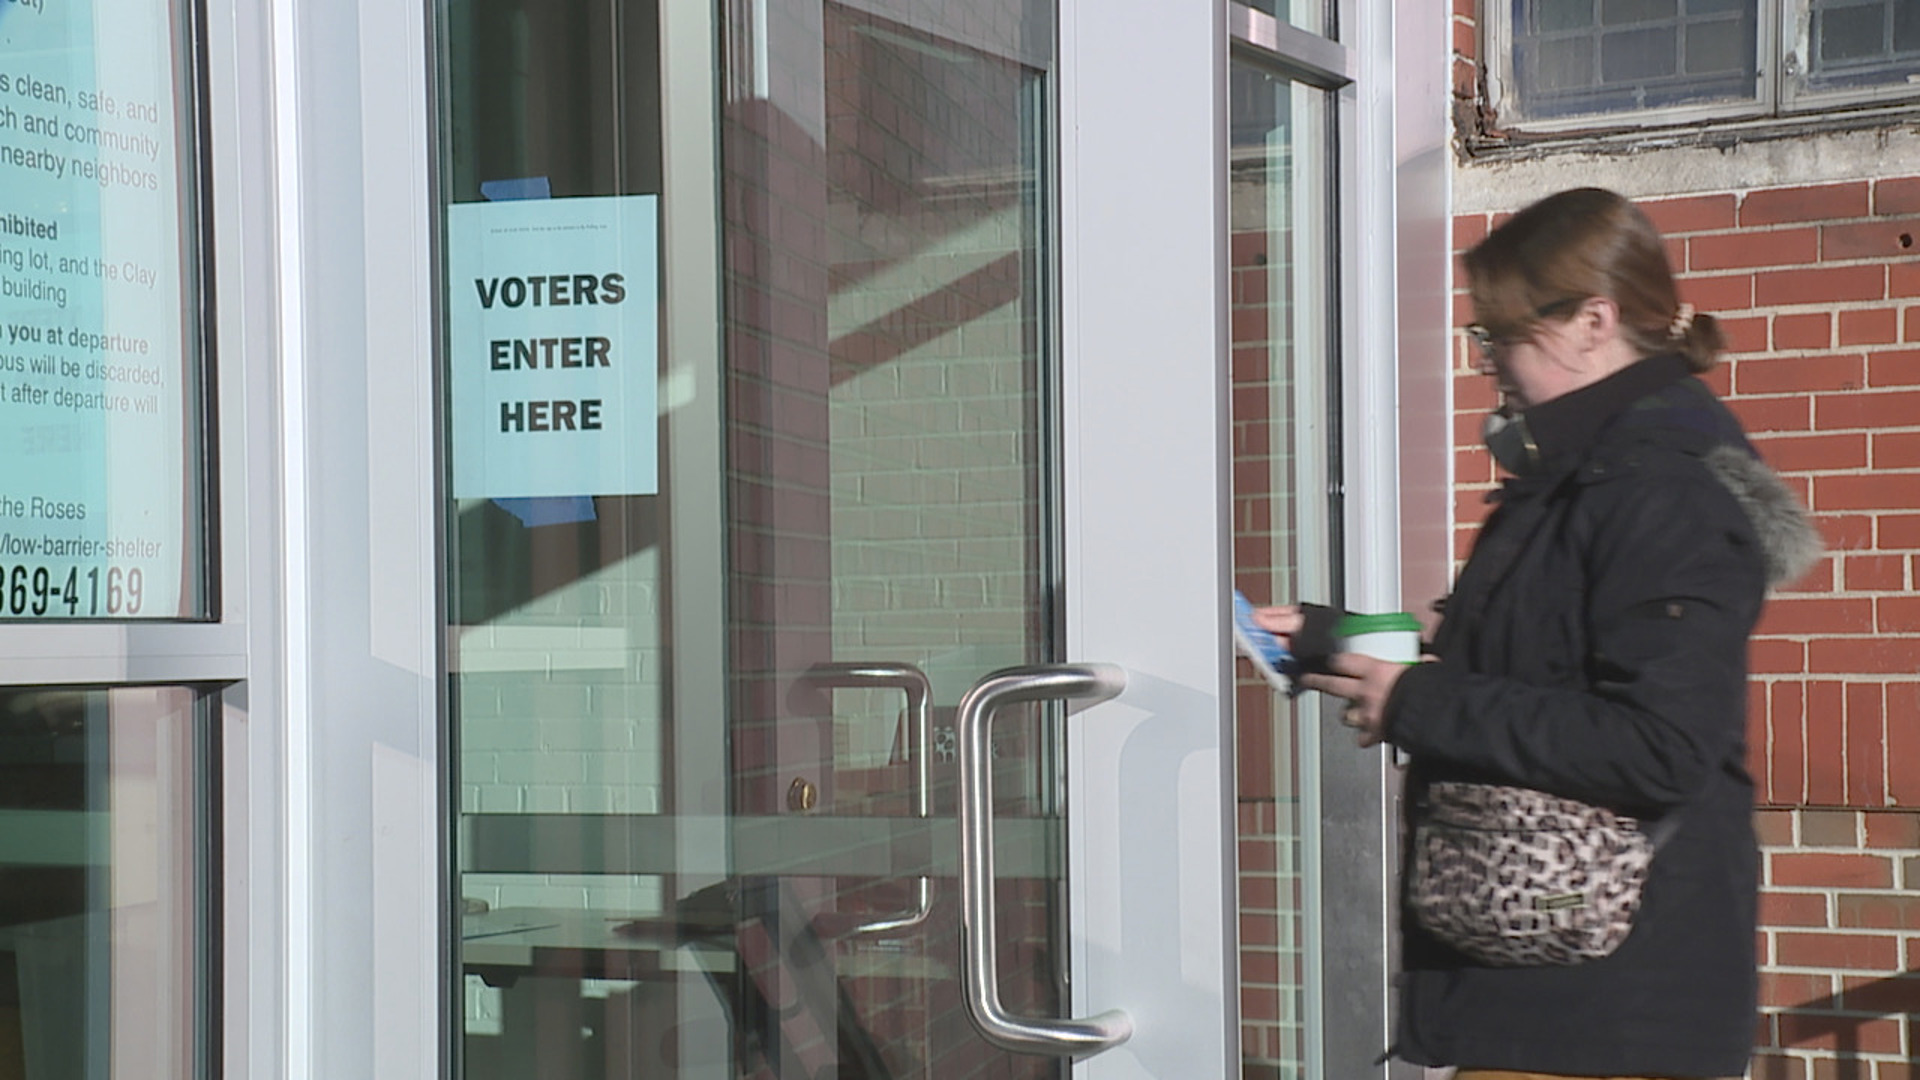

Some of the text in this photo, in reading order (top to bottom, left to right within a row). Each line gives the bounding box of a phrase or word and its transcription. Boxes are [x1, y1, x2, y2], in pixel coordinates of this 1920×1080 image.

[16, 75, 71, 109] clean,
[78, 90, 120, 119] safe,
[127, 102, 157, 123] and
[24, 116, 58, 137] and
[65, 122, 158, 162] community
[1, 145, 157, 191] nearby neighbors
[29, 248, 53, 274] lot,
[59, 257, 89, 276] and
[94, 257, 118, 280] the
[123, 262, 157, 289] Clay
[3, 276, 67, 308] building
[475, 273, 626, 309] VOTERS
[8, 324, 41, 345] you
[47, 327, 63, 345] at
[68, 327, 148, 354] departure
[490, 336, 611, 371] ENTER
[30, 354, 56, 375] will
[61, 356, 80, 378] be
[85, 360, 164, 388] discarded,
[11, 383, 48, 405] after
[54, 387, 129, 412] departure
[134, 396, 158, 414] will
[500, 399, 602, 432] HERE
[0, 495, 86, 520] he Roses
[0, 532, 162, 558] /low-barrier-shelter
